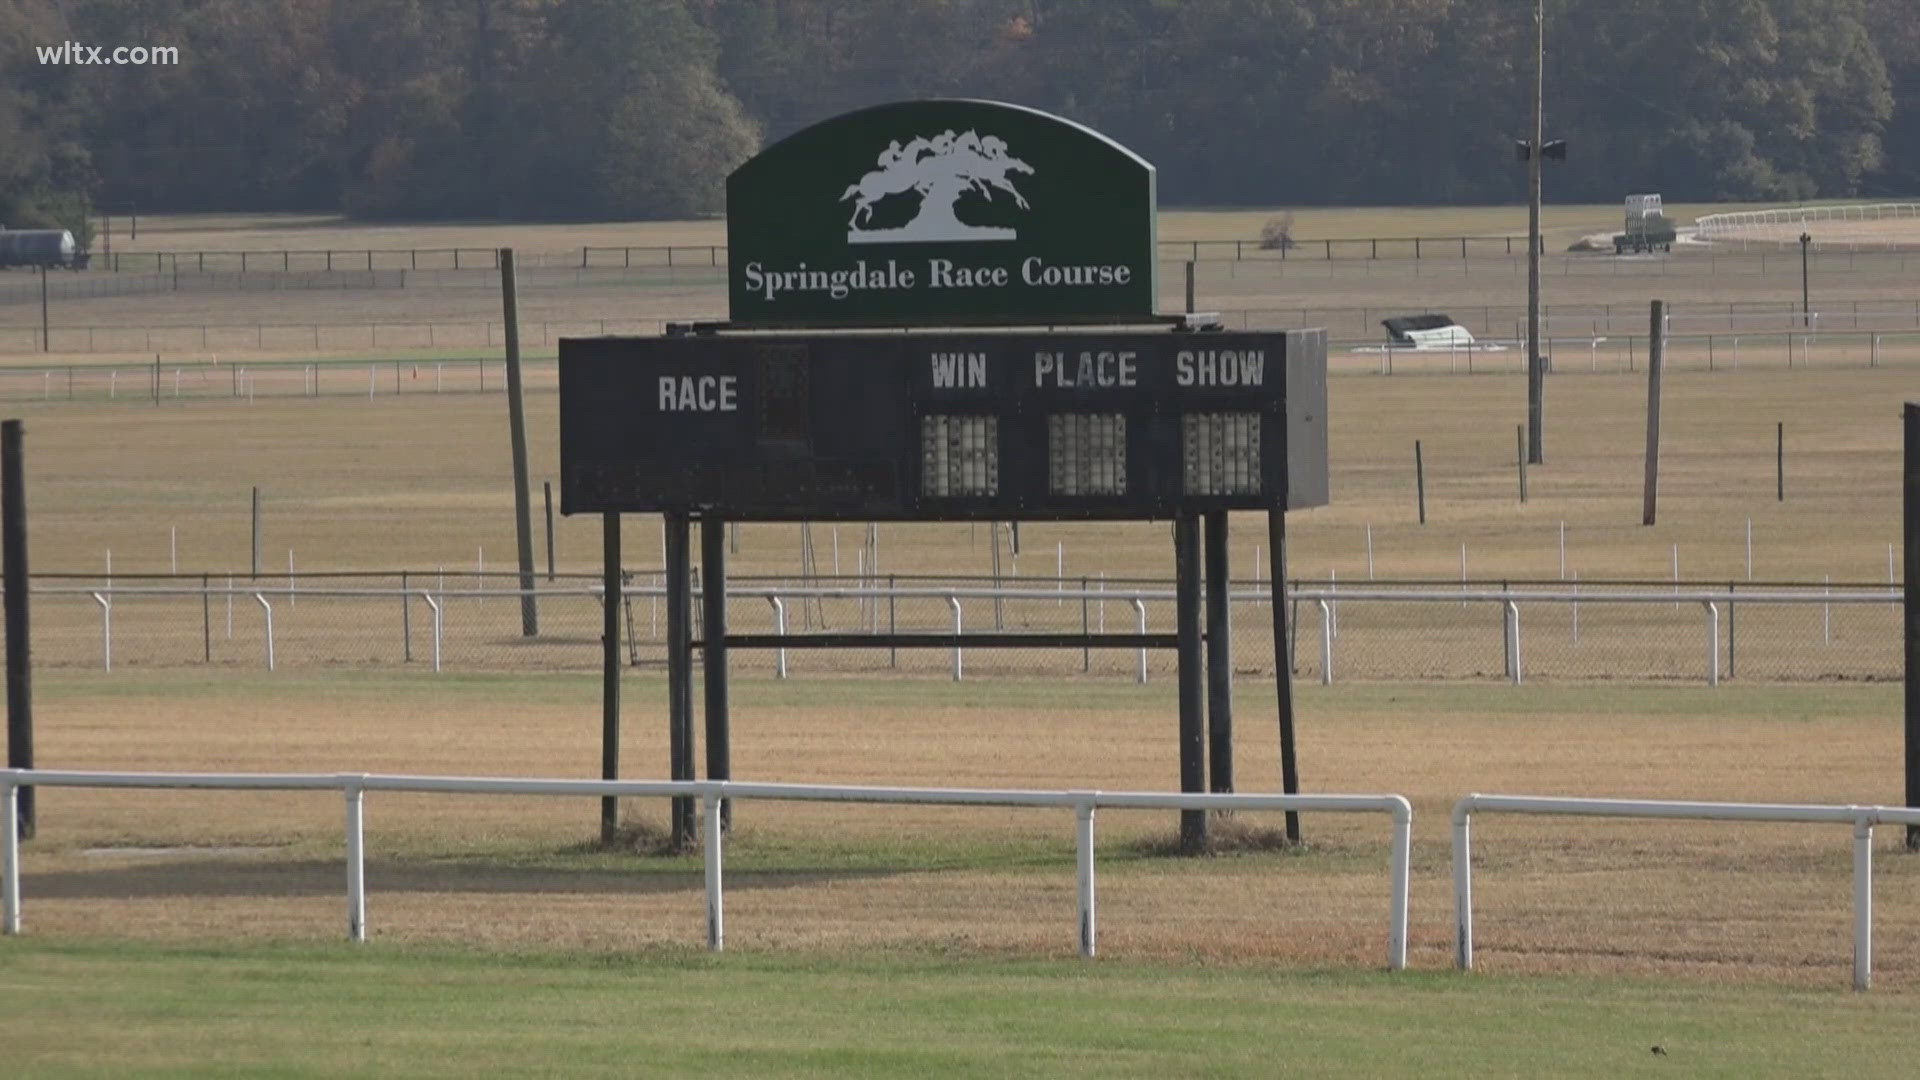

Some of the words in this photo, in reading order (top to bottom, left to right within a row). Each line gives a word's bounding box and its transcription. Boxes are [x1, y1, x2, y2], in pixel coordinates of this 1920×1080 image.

[745, 259, 915, 300] Springdale
[928, 259, 1008, 288] Race
[1021, 257, 1131, 286] Course
[931, 352, 988, 388] WIN
[1034, 351, 1137, 388] PLACE
[1176, 350, 1265, 387] SHOW
[658, 376, 738, 412] RACE
